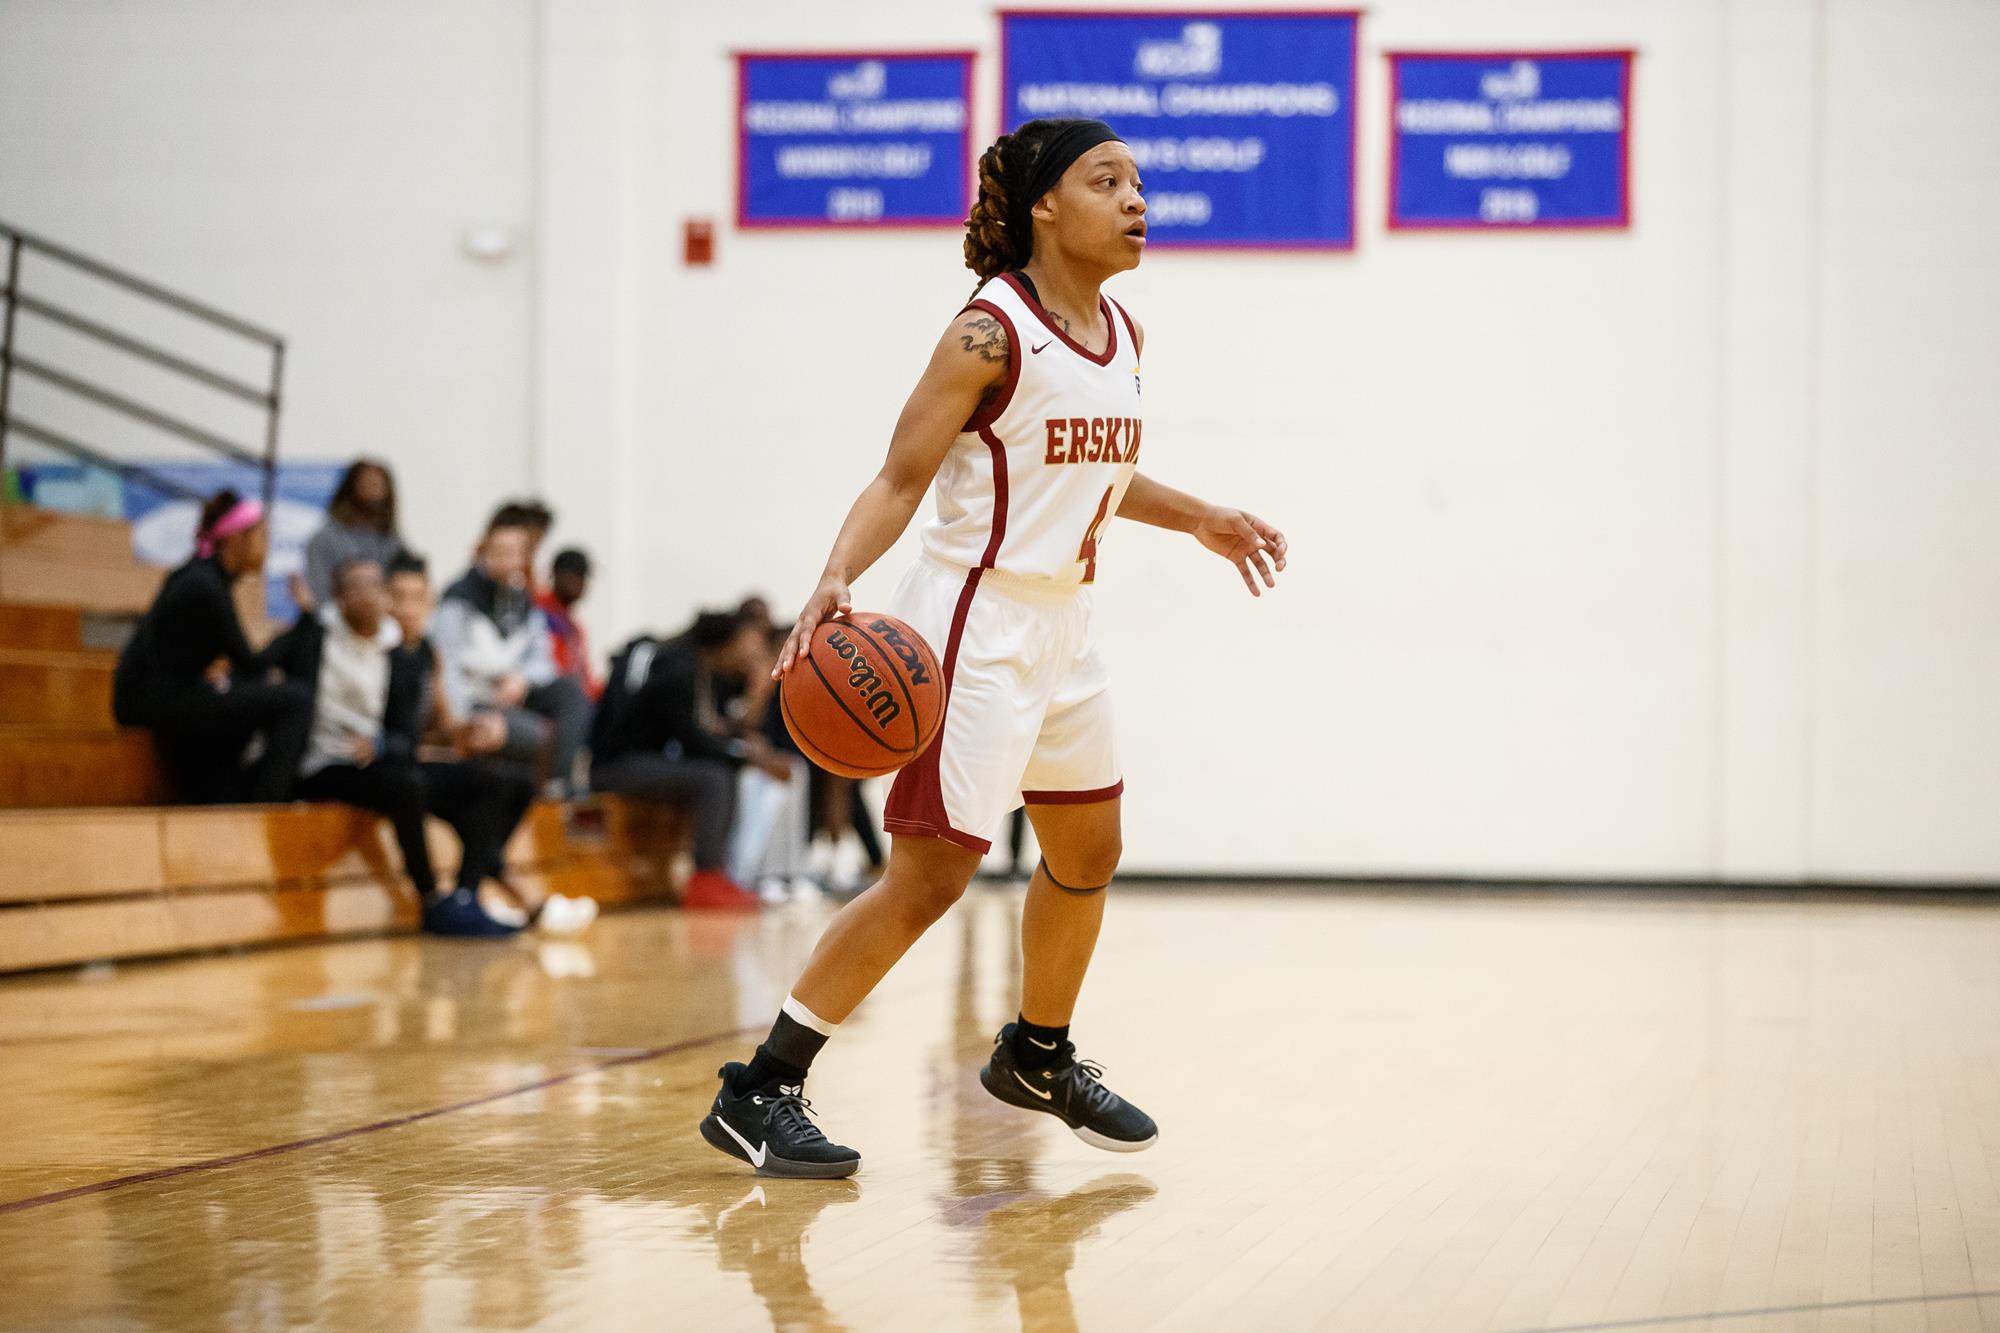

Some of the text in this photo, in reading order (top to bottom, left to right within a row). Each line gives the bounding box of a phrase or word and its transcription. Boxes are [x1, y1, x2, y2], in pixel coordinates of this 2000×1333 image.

[1020, 85, 1338, 114] NATIONAL CHAMPIONS
[1183, 140, 1264, 169] GOLF
[868, 620, 930, 686] NCAA
[825, 630, 901, 731] Wilson
